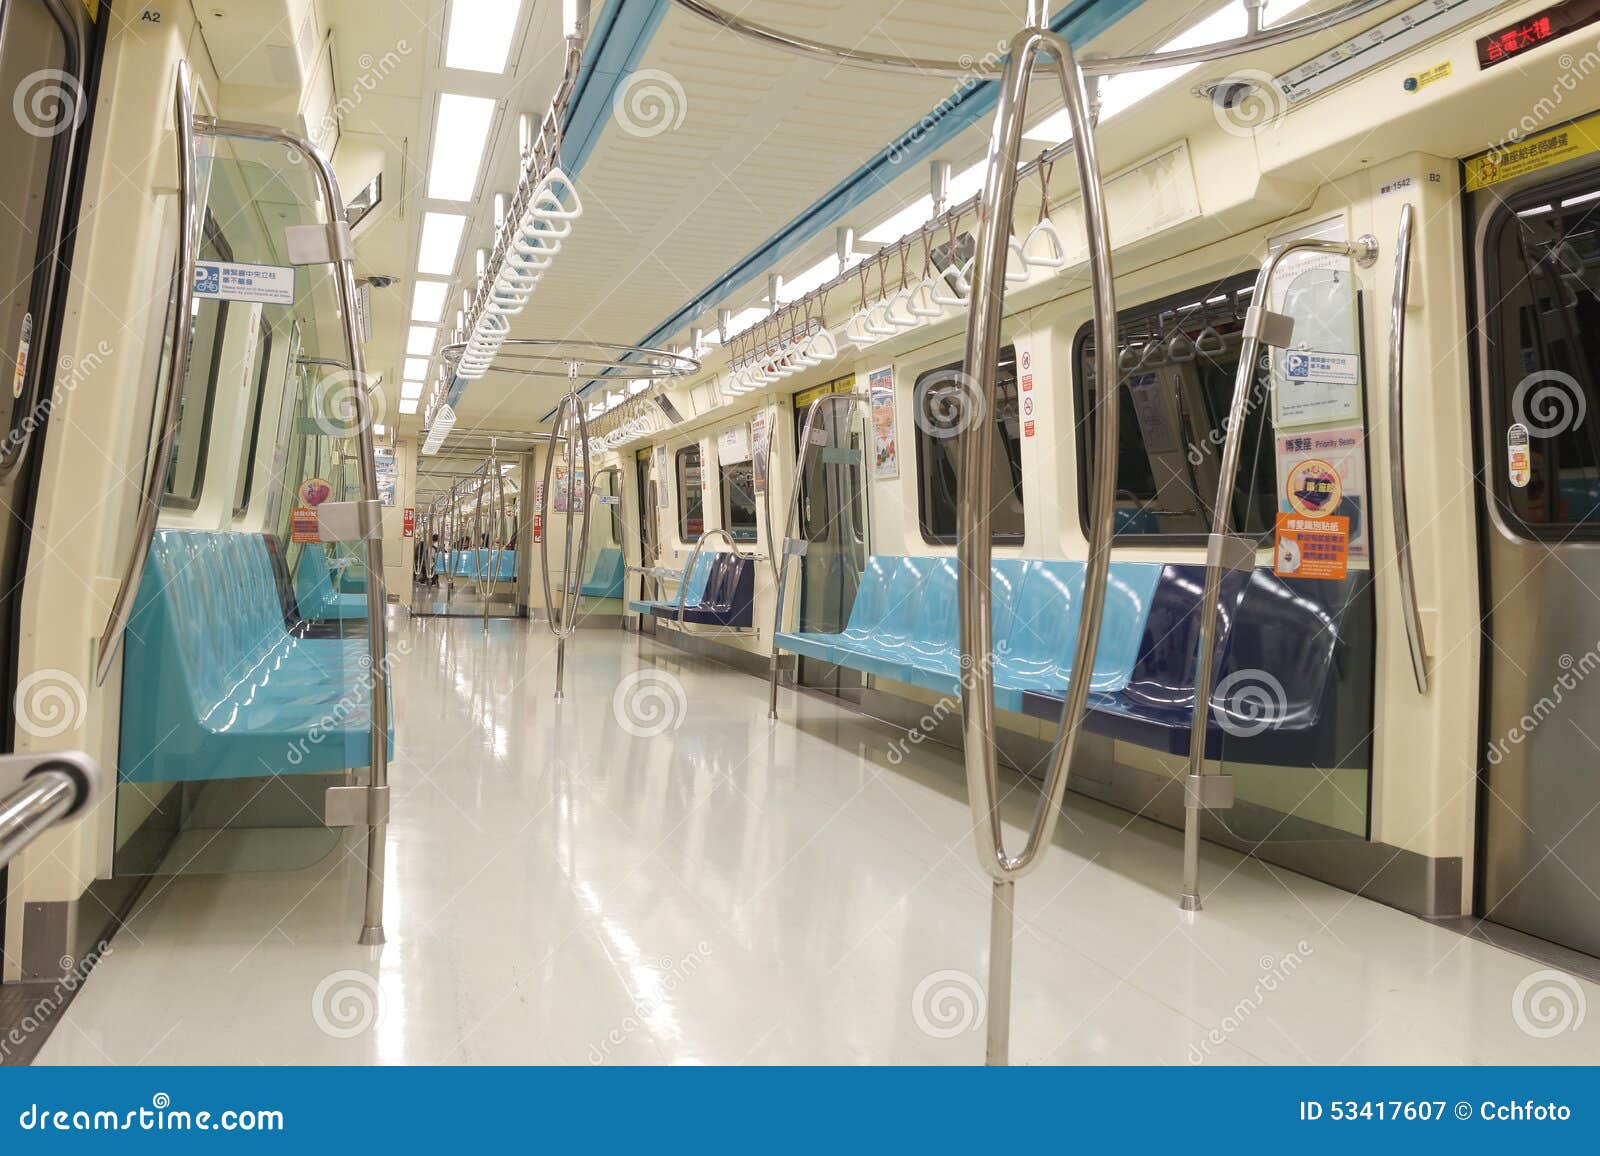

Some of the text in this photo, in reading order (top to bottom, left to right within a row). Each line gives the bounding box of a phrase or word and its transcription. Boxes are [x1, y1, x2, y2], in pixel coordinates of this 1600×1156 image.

[142, 10, 161, 23] A2
[1429, 173, 1441, 183] B2
[1315, 440, 1337, 448] Priority
